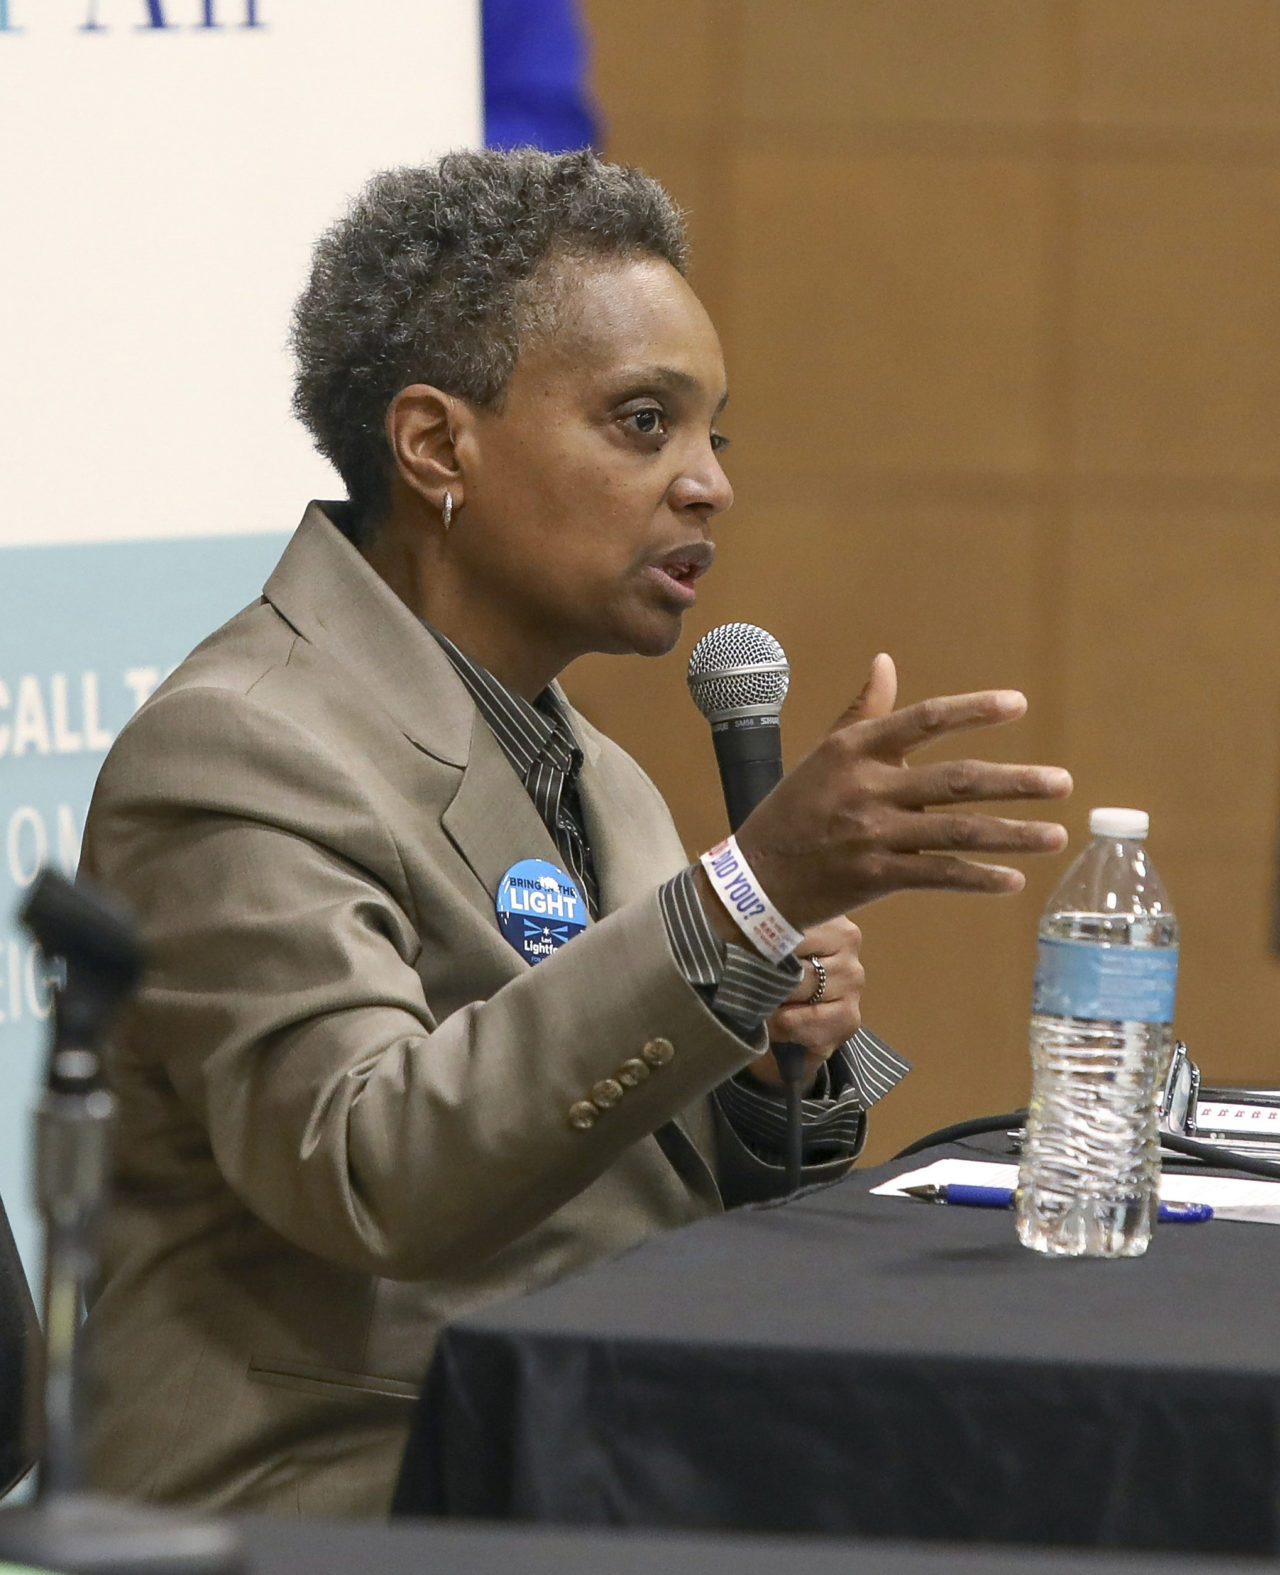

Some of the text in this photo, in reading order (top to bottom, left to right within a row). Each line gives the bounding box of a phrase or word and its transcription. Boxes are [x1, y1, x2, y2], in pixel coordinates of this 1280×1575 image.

[711, 848, 739, 879] DID
[509, 877, 542, 891] BRING
[724, 871, 766, 920] YOU?
[509, 887, 577, 919] LIGHT
